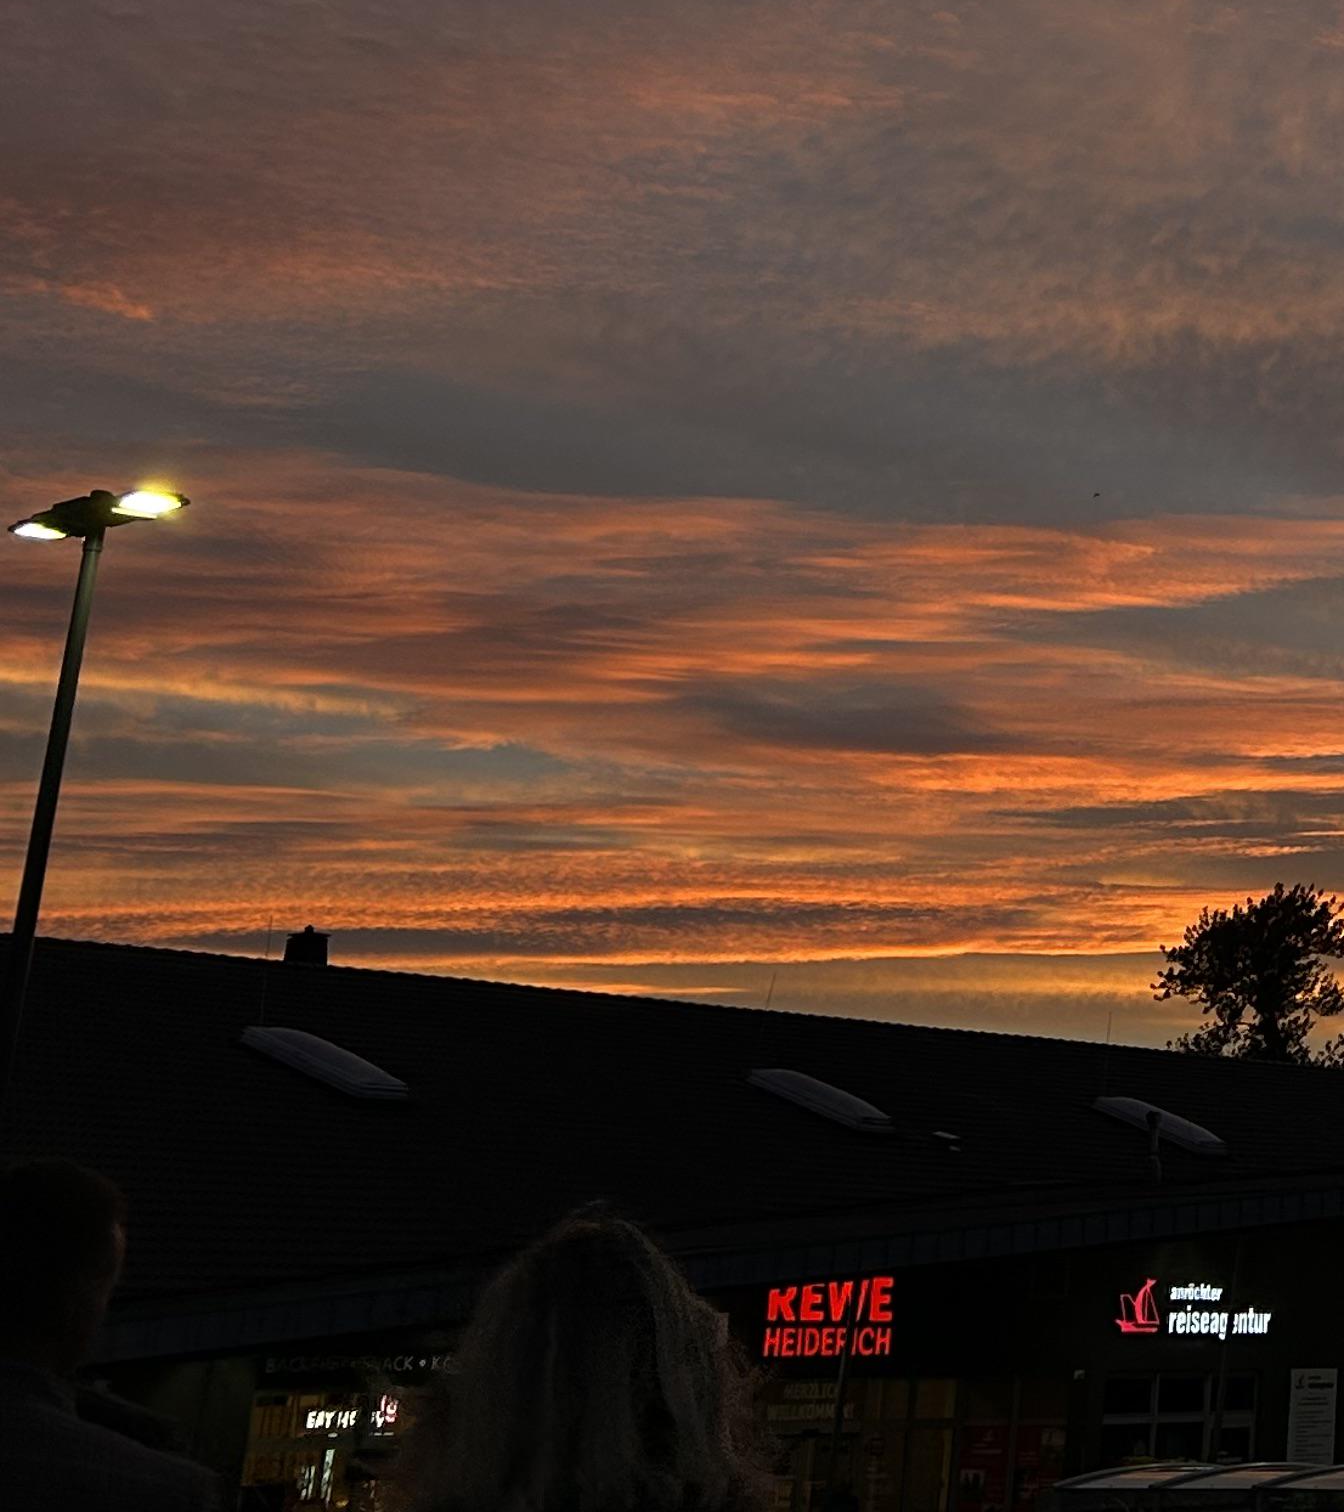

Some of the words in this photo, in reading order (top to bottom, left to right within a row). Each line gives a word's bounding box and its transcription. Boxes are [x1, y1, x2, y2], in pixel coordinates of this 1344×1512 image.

[767, 1276, 894, 1321] REWE
[763, 1327, 891, 1356] HEIDERICH
[783, 1383, 839, 1399] HERZLIC
